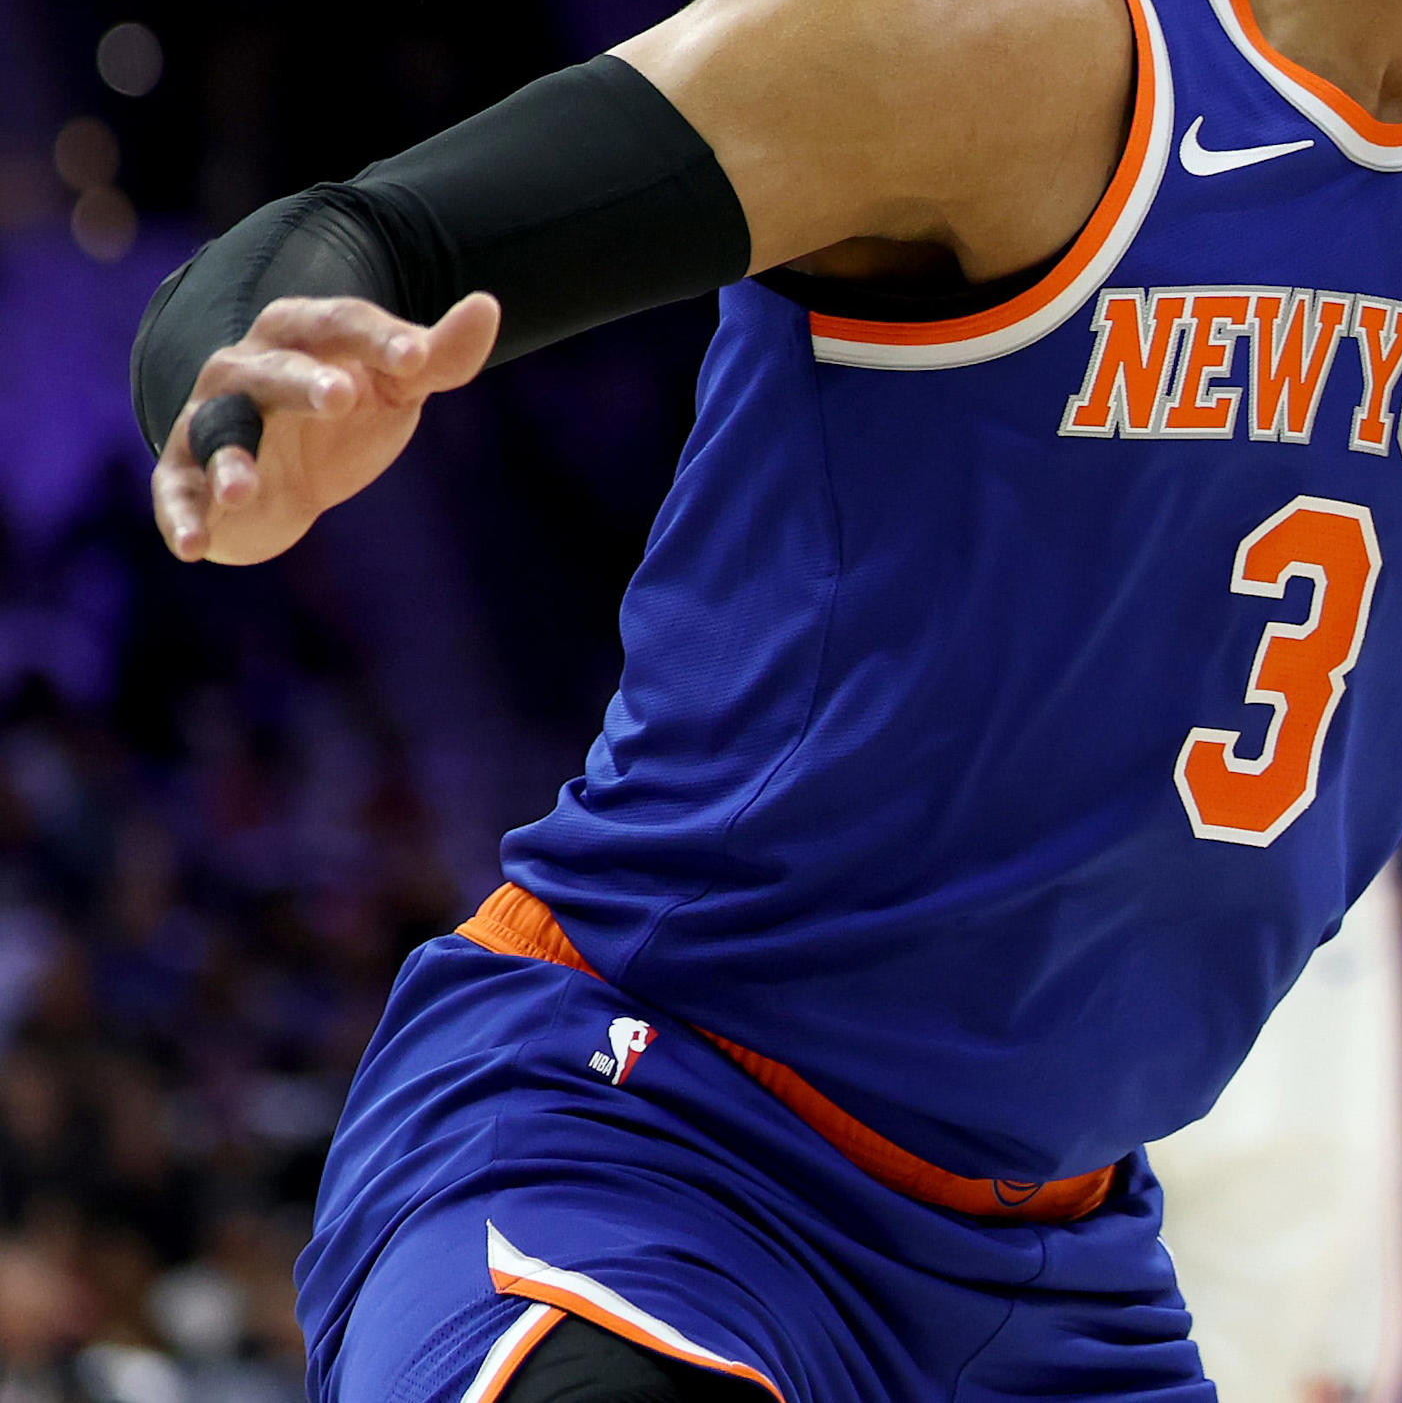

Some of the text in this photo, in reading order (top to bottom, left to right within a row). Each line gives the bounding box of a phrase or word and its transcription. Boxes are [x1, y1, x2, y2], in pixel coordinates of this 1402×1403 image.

[1056, 285, 1354, 445] NEW
[1172, 494, 1383, 848] 3
[589, 1051, 615, 1076] NBA
